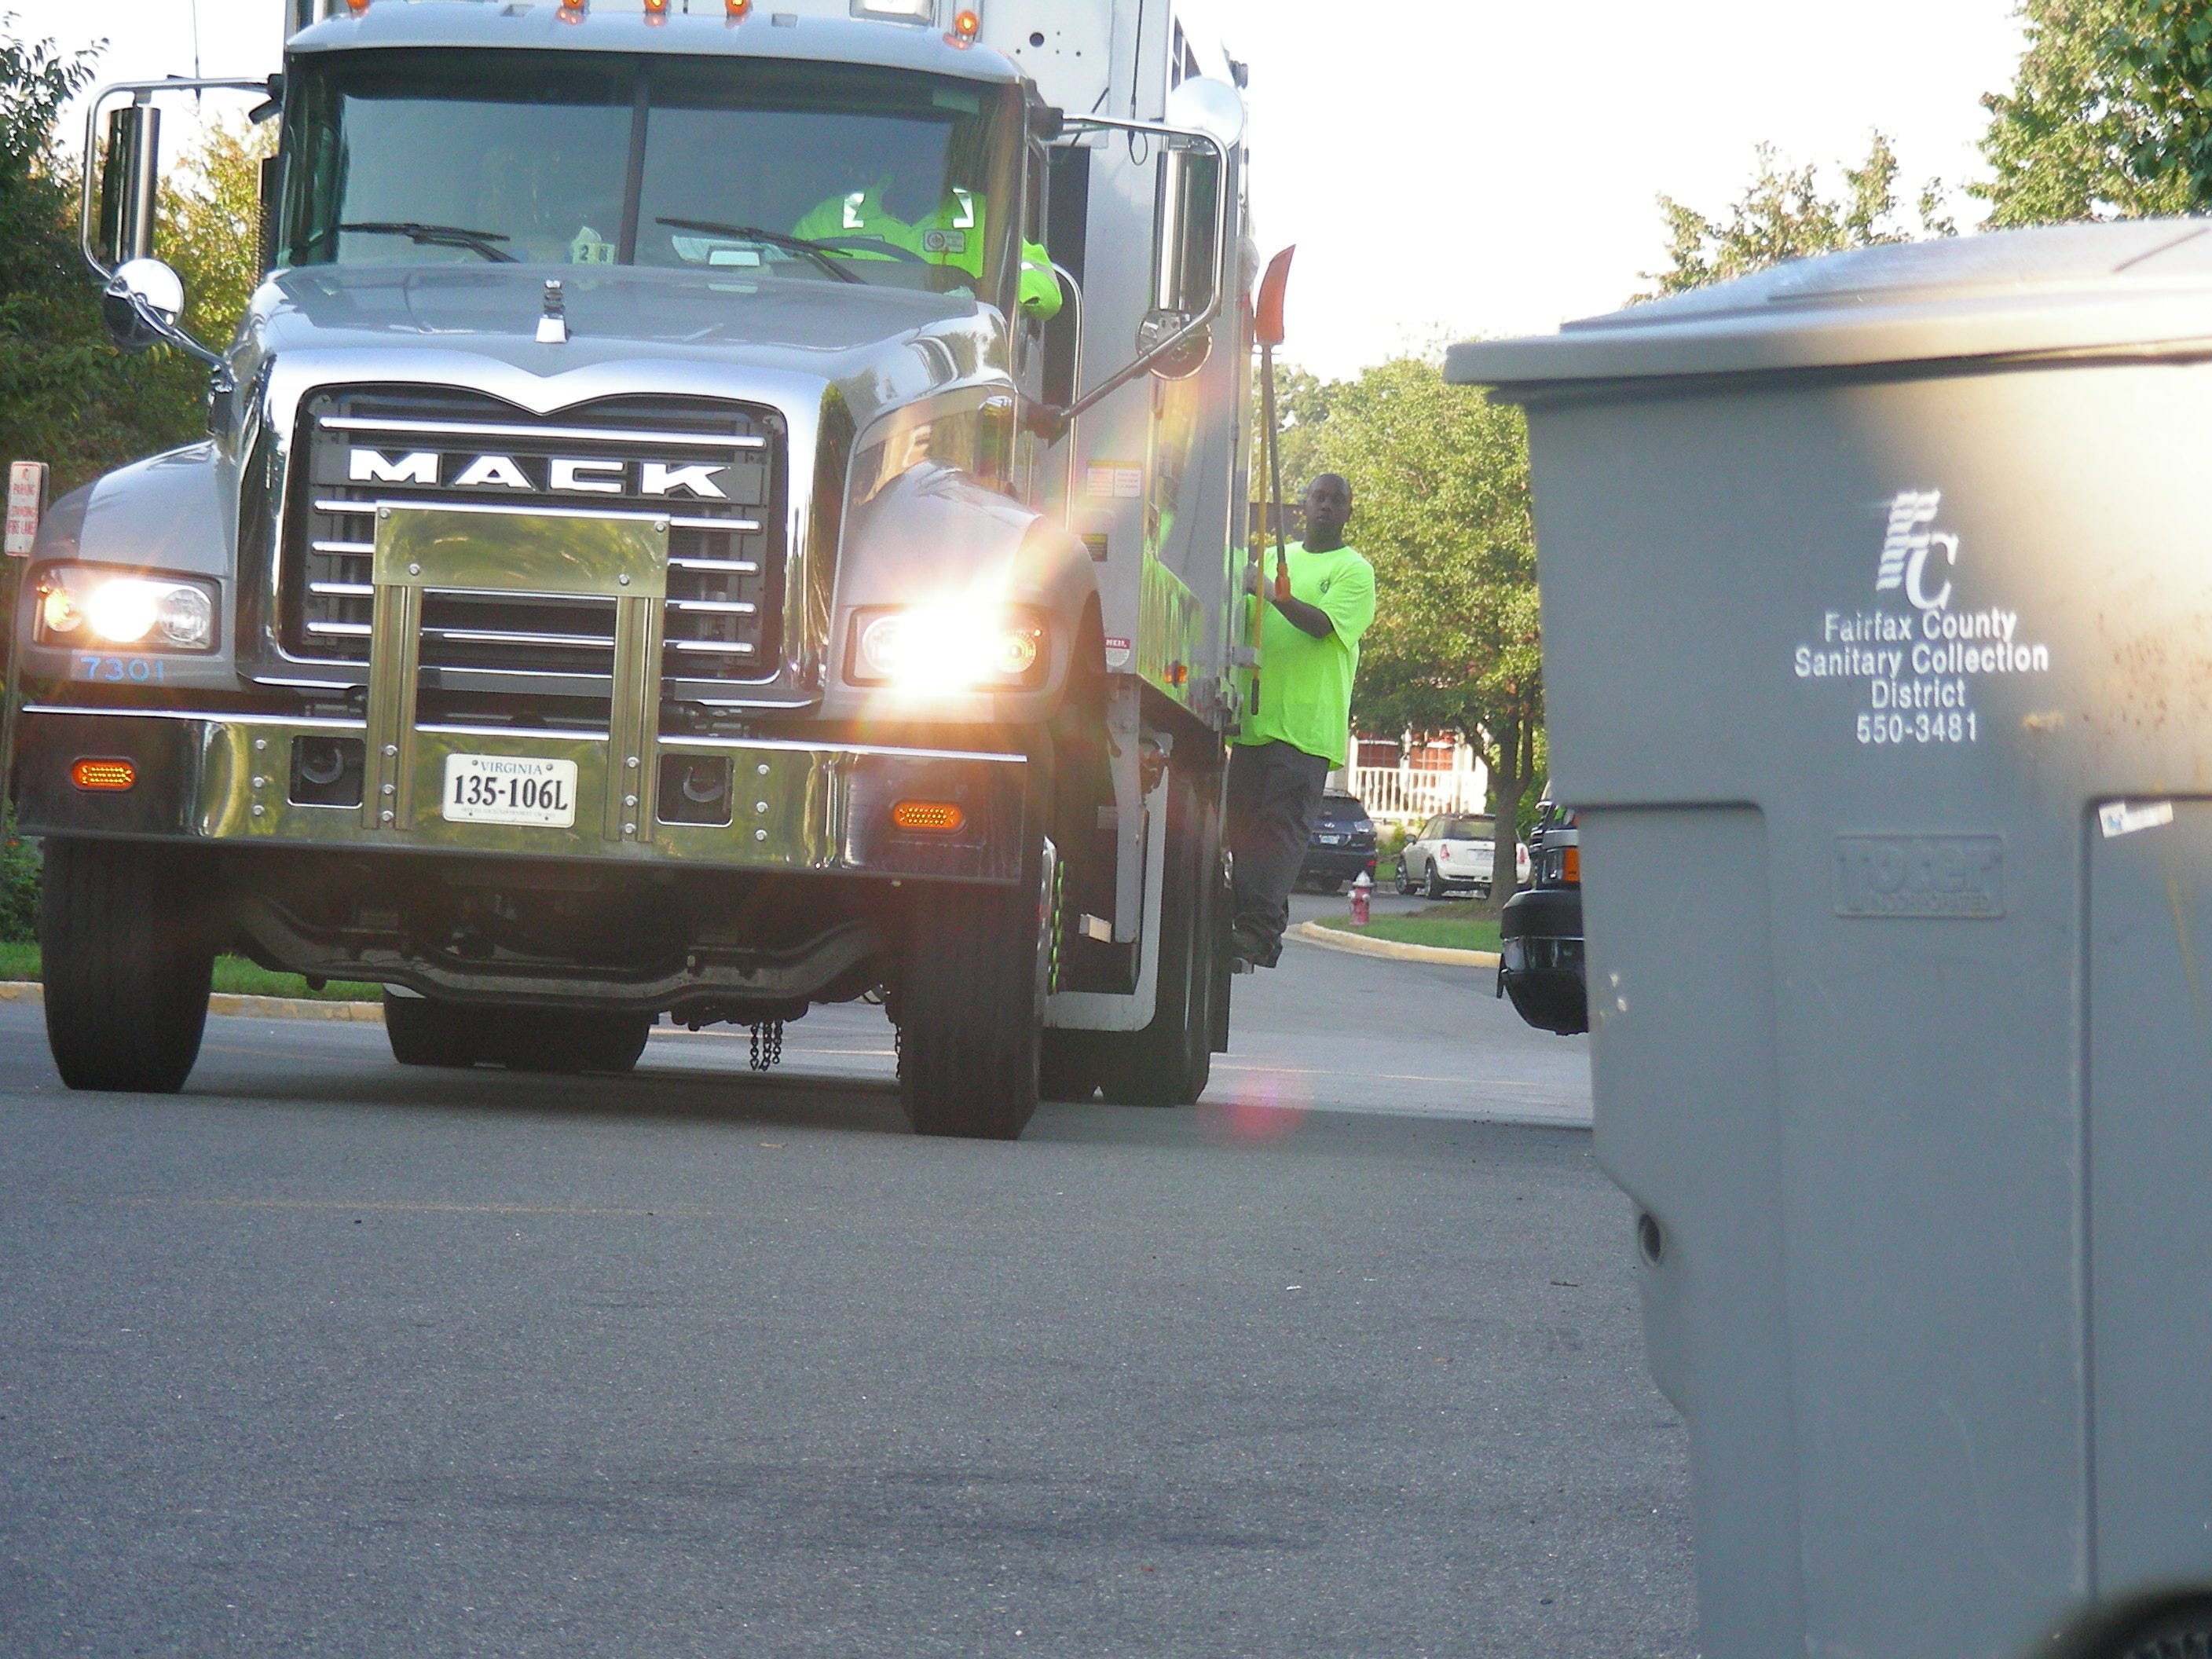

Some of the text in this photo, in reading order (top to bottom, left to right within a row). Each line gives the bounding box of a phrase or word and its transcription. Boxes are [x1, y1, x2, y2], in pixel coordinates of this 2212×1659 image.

[350, 449, 731, 500] MACK
[1825, 606, 2017, 643] Fairfax County
[80, 657, 165, 683] 7301
[1794, 640, 2049, 679] Sanitary Collection
[1871, 677, 1966, 709] District
[1856, 711, 1977, 744] 550-3481
[481, 761, 542, 775] VIRGINIA
[454, 775, 568, 811] 135-106L
